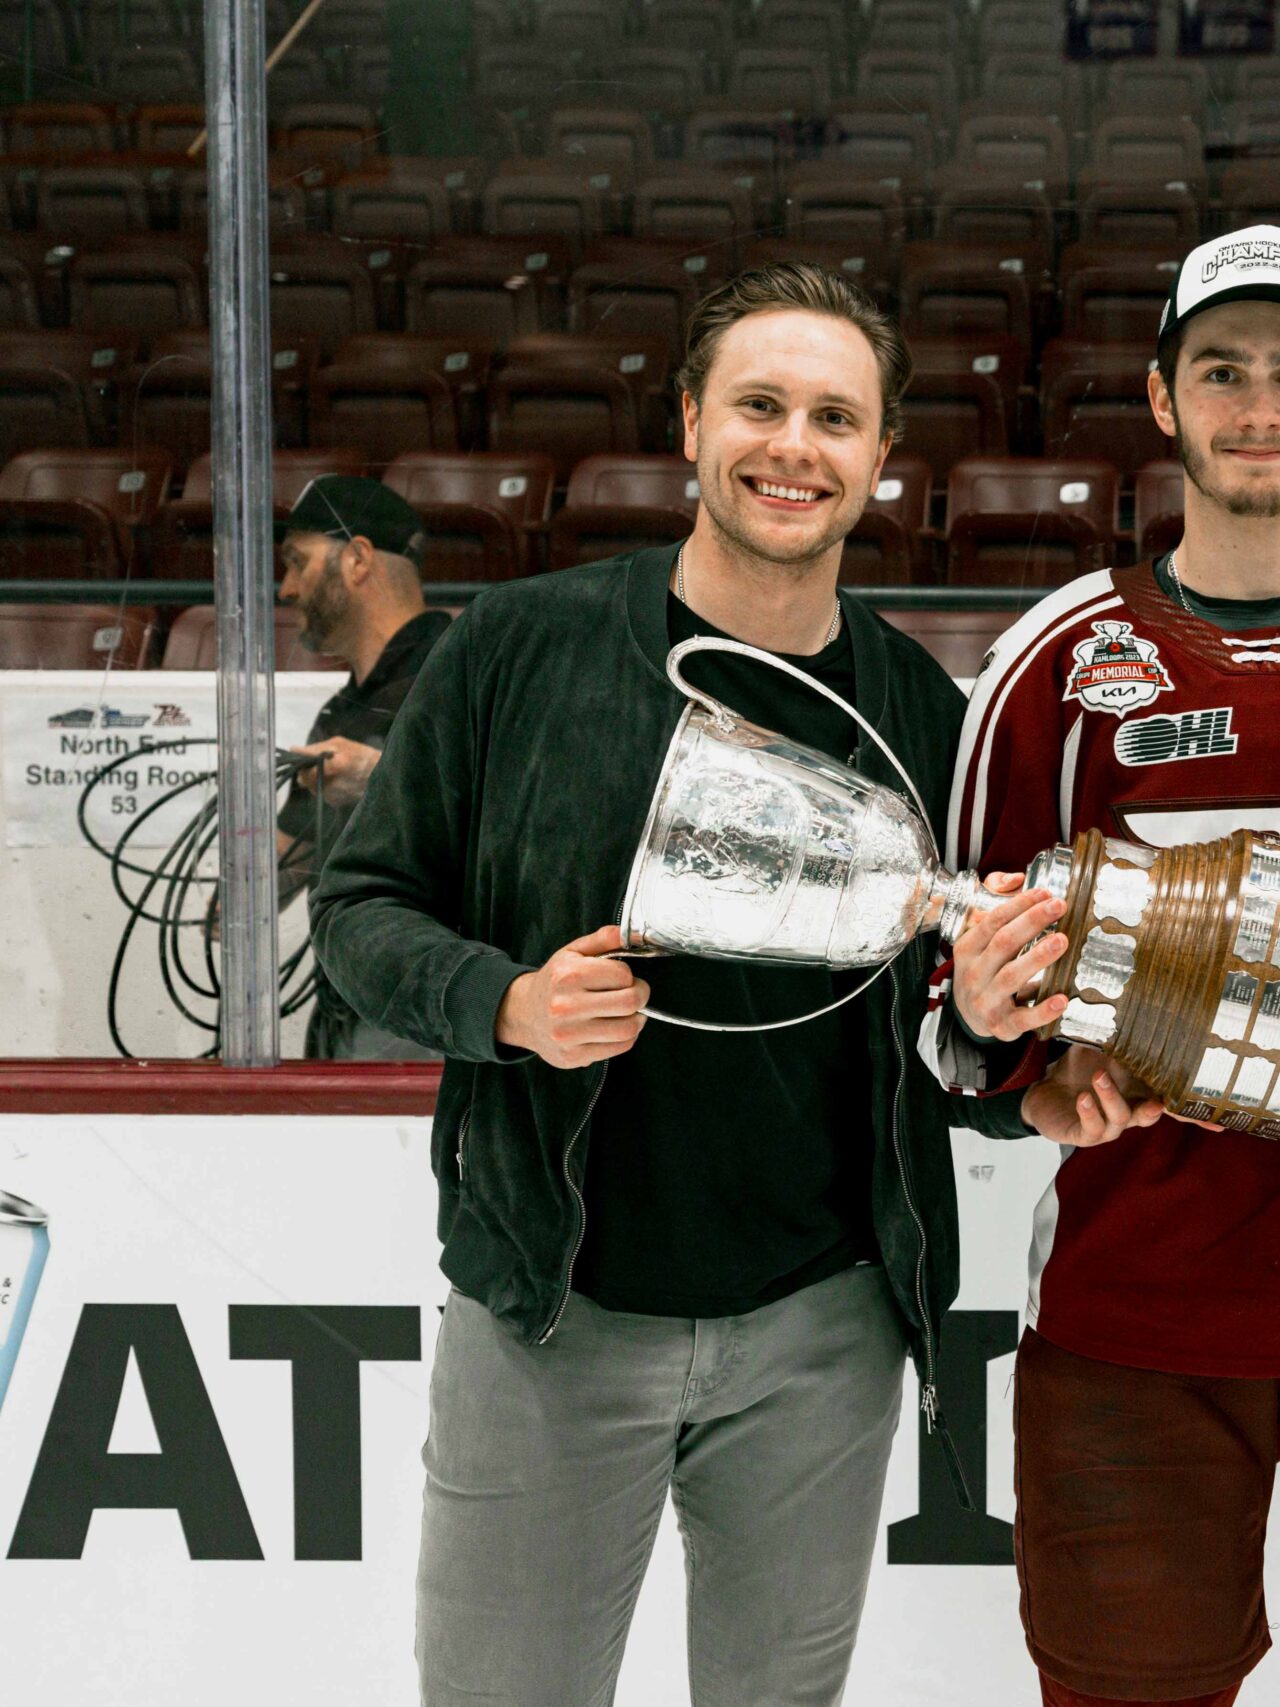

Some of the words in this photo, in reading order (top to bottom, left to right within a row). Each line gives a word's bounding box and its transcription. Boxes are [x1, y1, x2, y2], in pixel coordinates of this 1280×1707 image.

[1219, 241, 1253, 252] ONTARIO
[1091, 665, 1145, 682] MEMORIAL
[60, 735, 128, 755] North
[139, 735, 187, 755] End
[1115, 708, 1237, 765] OHL
[26, 764, 138, 791] Standing
[111, 796, 137, 814] 53
